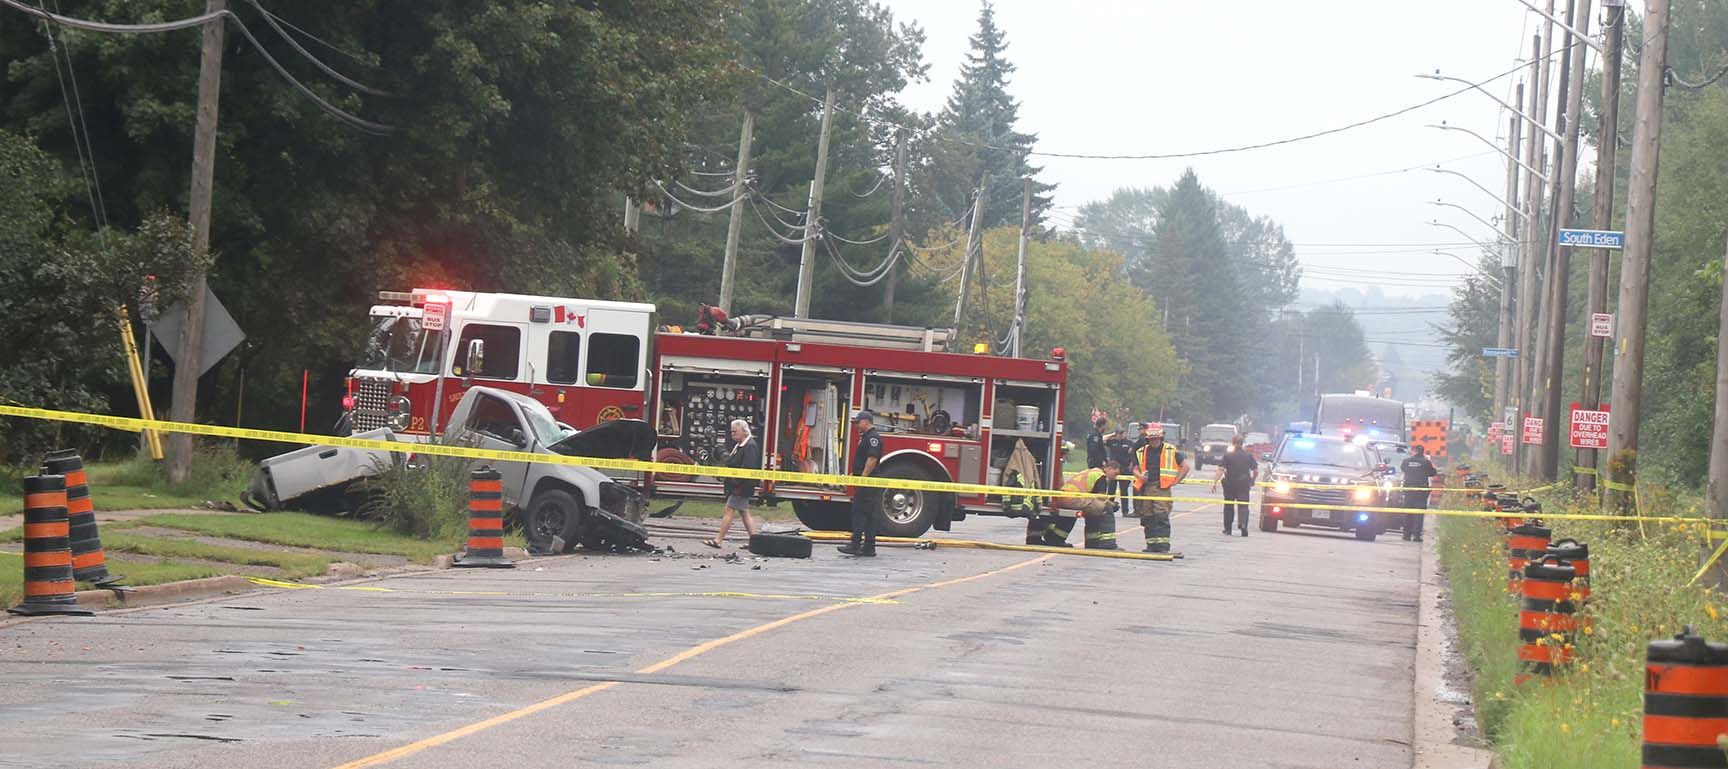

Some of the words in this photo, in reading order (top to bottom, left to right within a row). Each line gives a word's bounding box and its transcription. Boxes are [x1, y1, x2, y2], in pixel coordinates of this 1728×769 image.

[1563, 231, 1593, 244] South
[1594, 233, 1619, 246] Eden
[410, 416, 425, 430] P2
[1574, 411, 1608, 424] DANGER
[1573, 430, 1607, 440] OVERHEAD
[1580, 438, 1600, 446] WIRES
